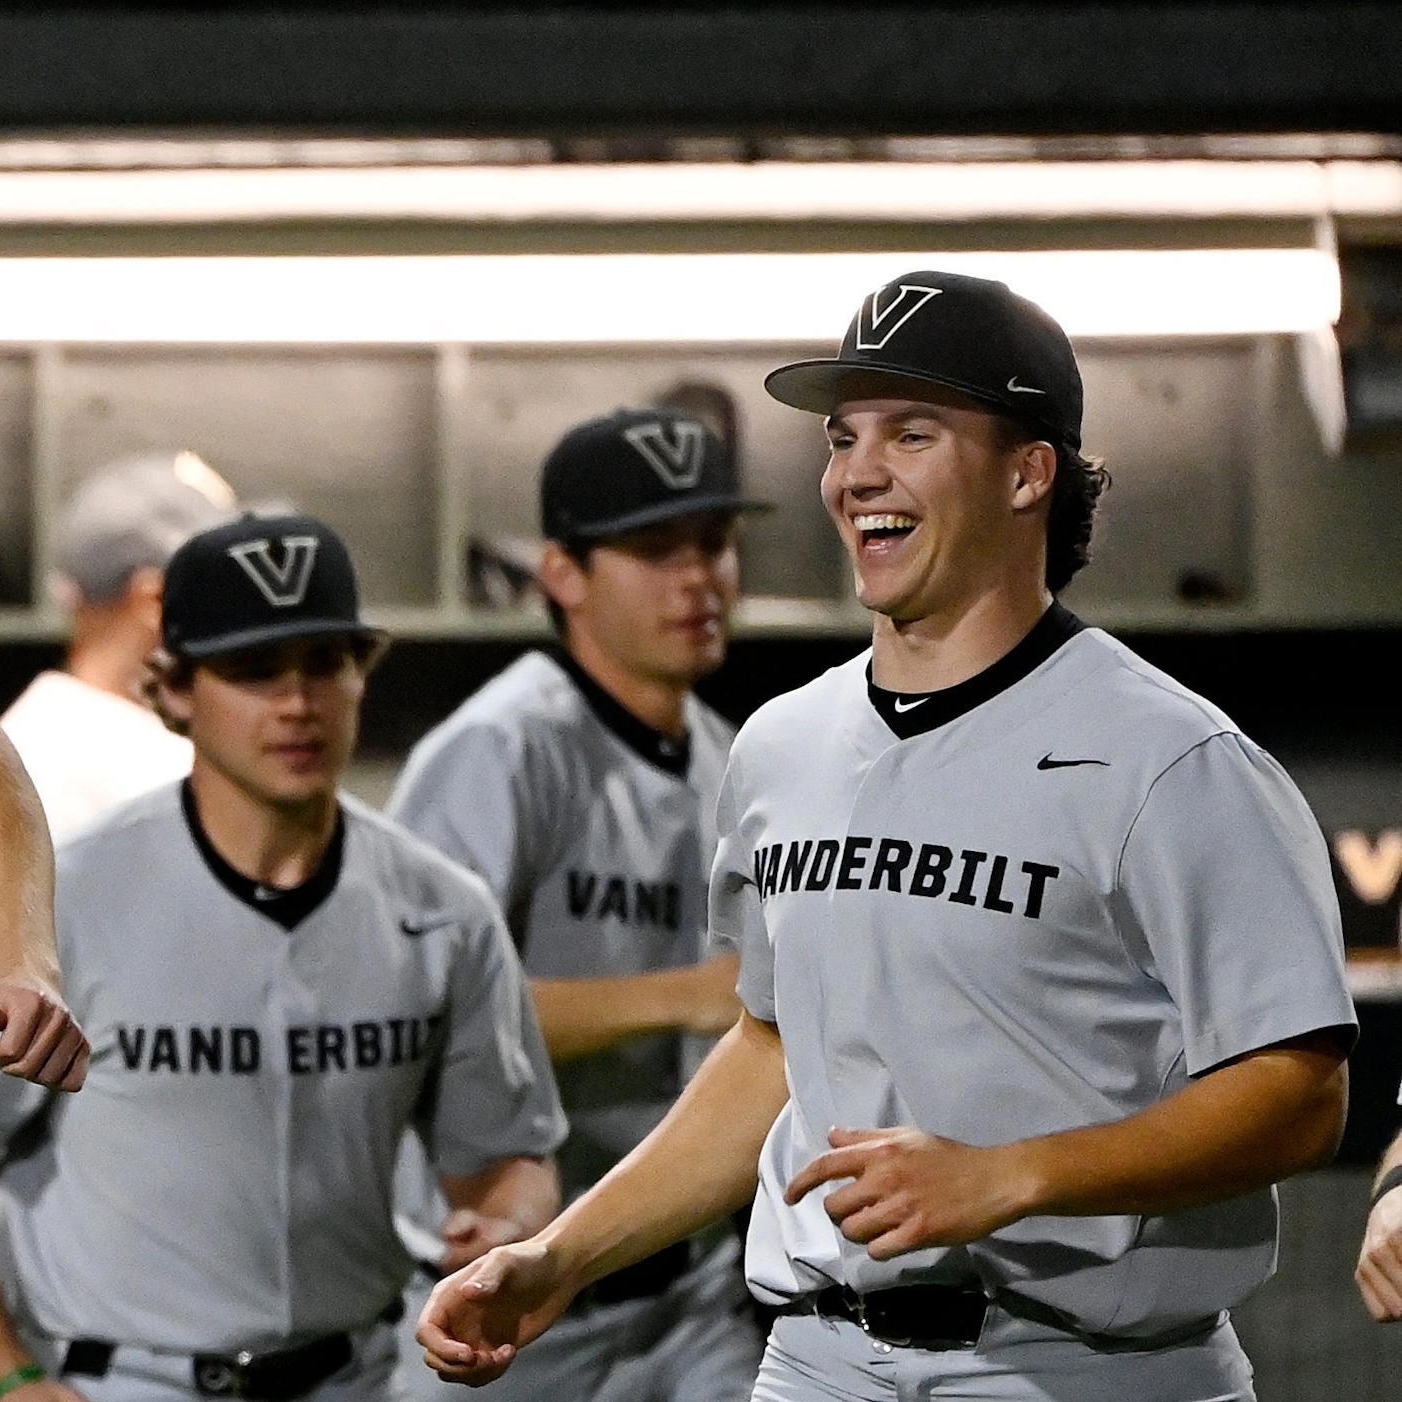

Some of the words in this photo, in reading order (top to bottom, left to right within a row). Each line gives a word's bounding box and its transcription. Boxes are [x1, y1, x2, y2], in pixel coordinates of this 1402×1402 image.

[855, 284, 943, 350] V
[624, 421, 705, 490] V
[228, 537, 319, 607] V
[754, 836, 1061, 920] VANDERBILT
